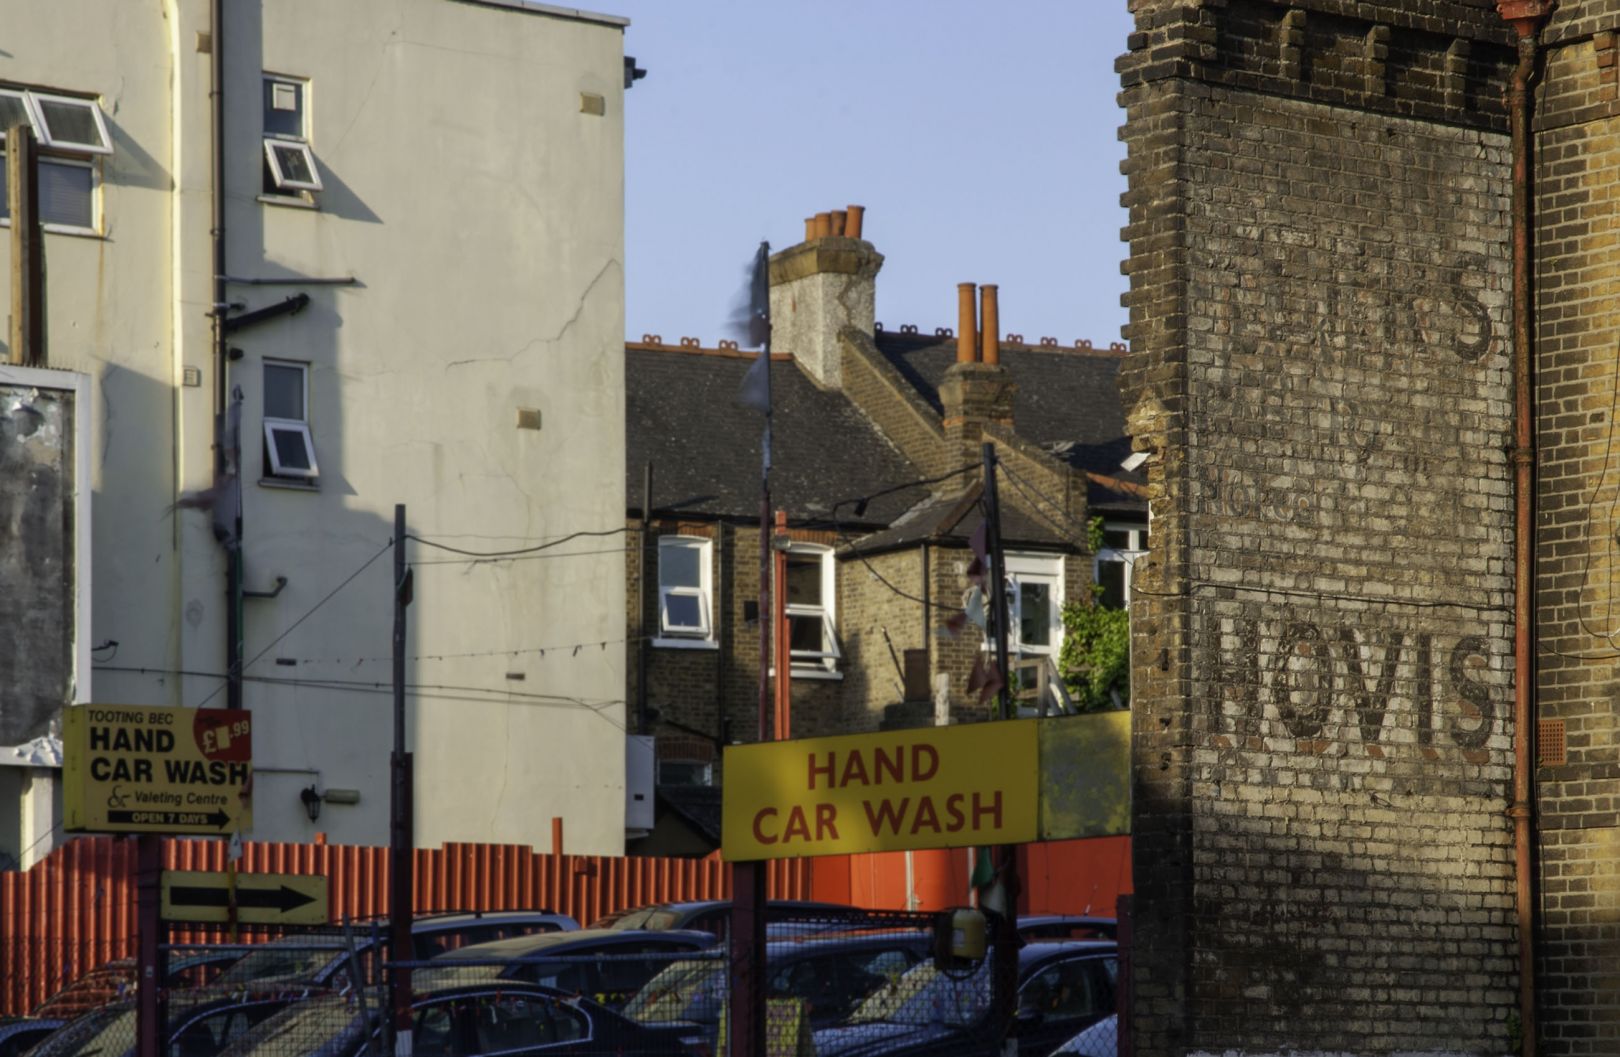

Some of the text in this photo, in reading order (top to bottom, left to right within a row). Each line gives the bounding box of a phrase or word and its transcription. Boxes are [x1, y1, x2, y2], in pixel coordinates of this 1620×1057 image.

[1210, 614, 1493, 750] HOVIS
[88, 710, 174, 725] TOOTING BEC
[90, 726, 175, 753] HAND
[203, 720, 249, 754] £.99
[91, 757, 248, 785] CAR WASH
[808, 743, 939, 790] HAND
[134, 791, 182, 807] Valeting
[186, 792, 228, 806] Centre
[132, 812, 208, 824] OPEN 7 DAYS
[752, 791, 1003, 845] CAR WASH
